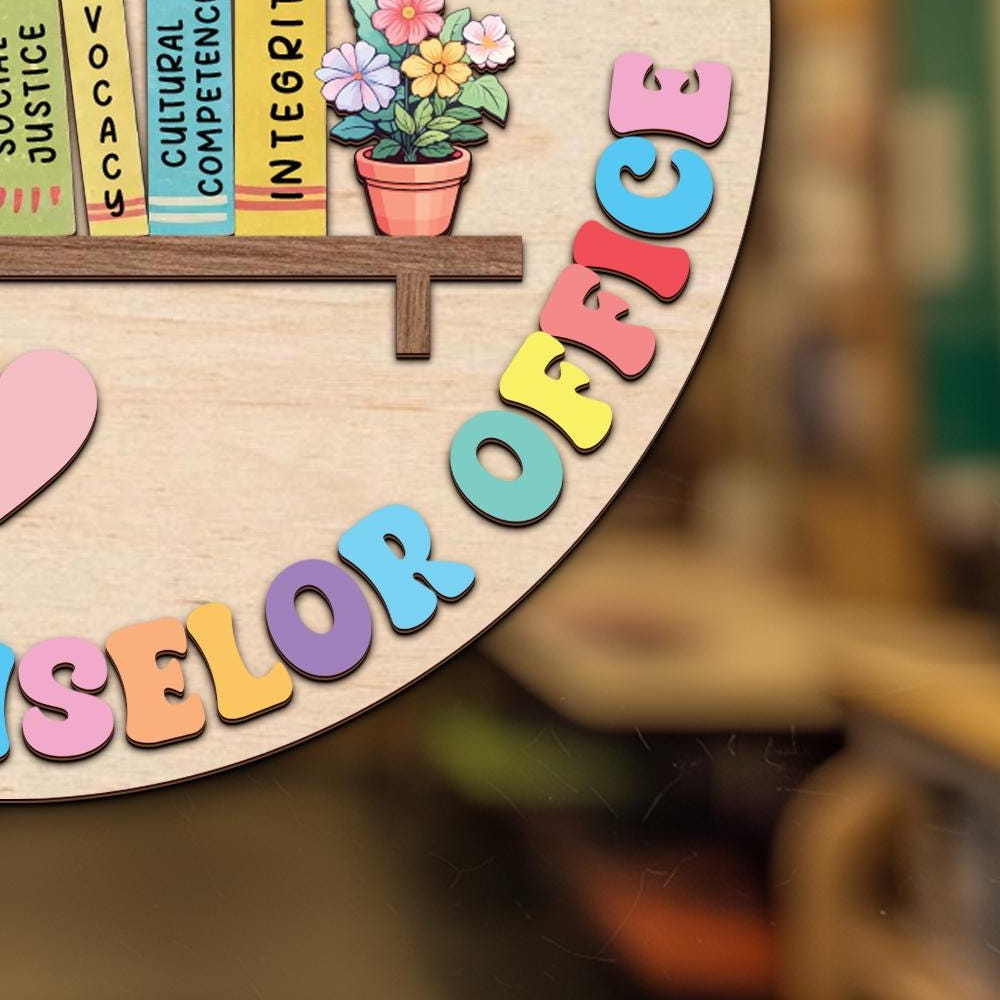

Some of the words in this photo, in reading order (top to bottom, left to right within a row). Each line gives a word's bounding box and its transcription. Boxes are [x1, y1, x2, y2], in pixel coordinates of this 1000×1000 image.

[18, 23, 57, 164] JUSTICE
[156, 18, 188, 168] CULTURAL
[449, 50, 734, 529] OFFICE
